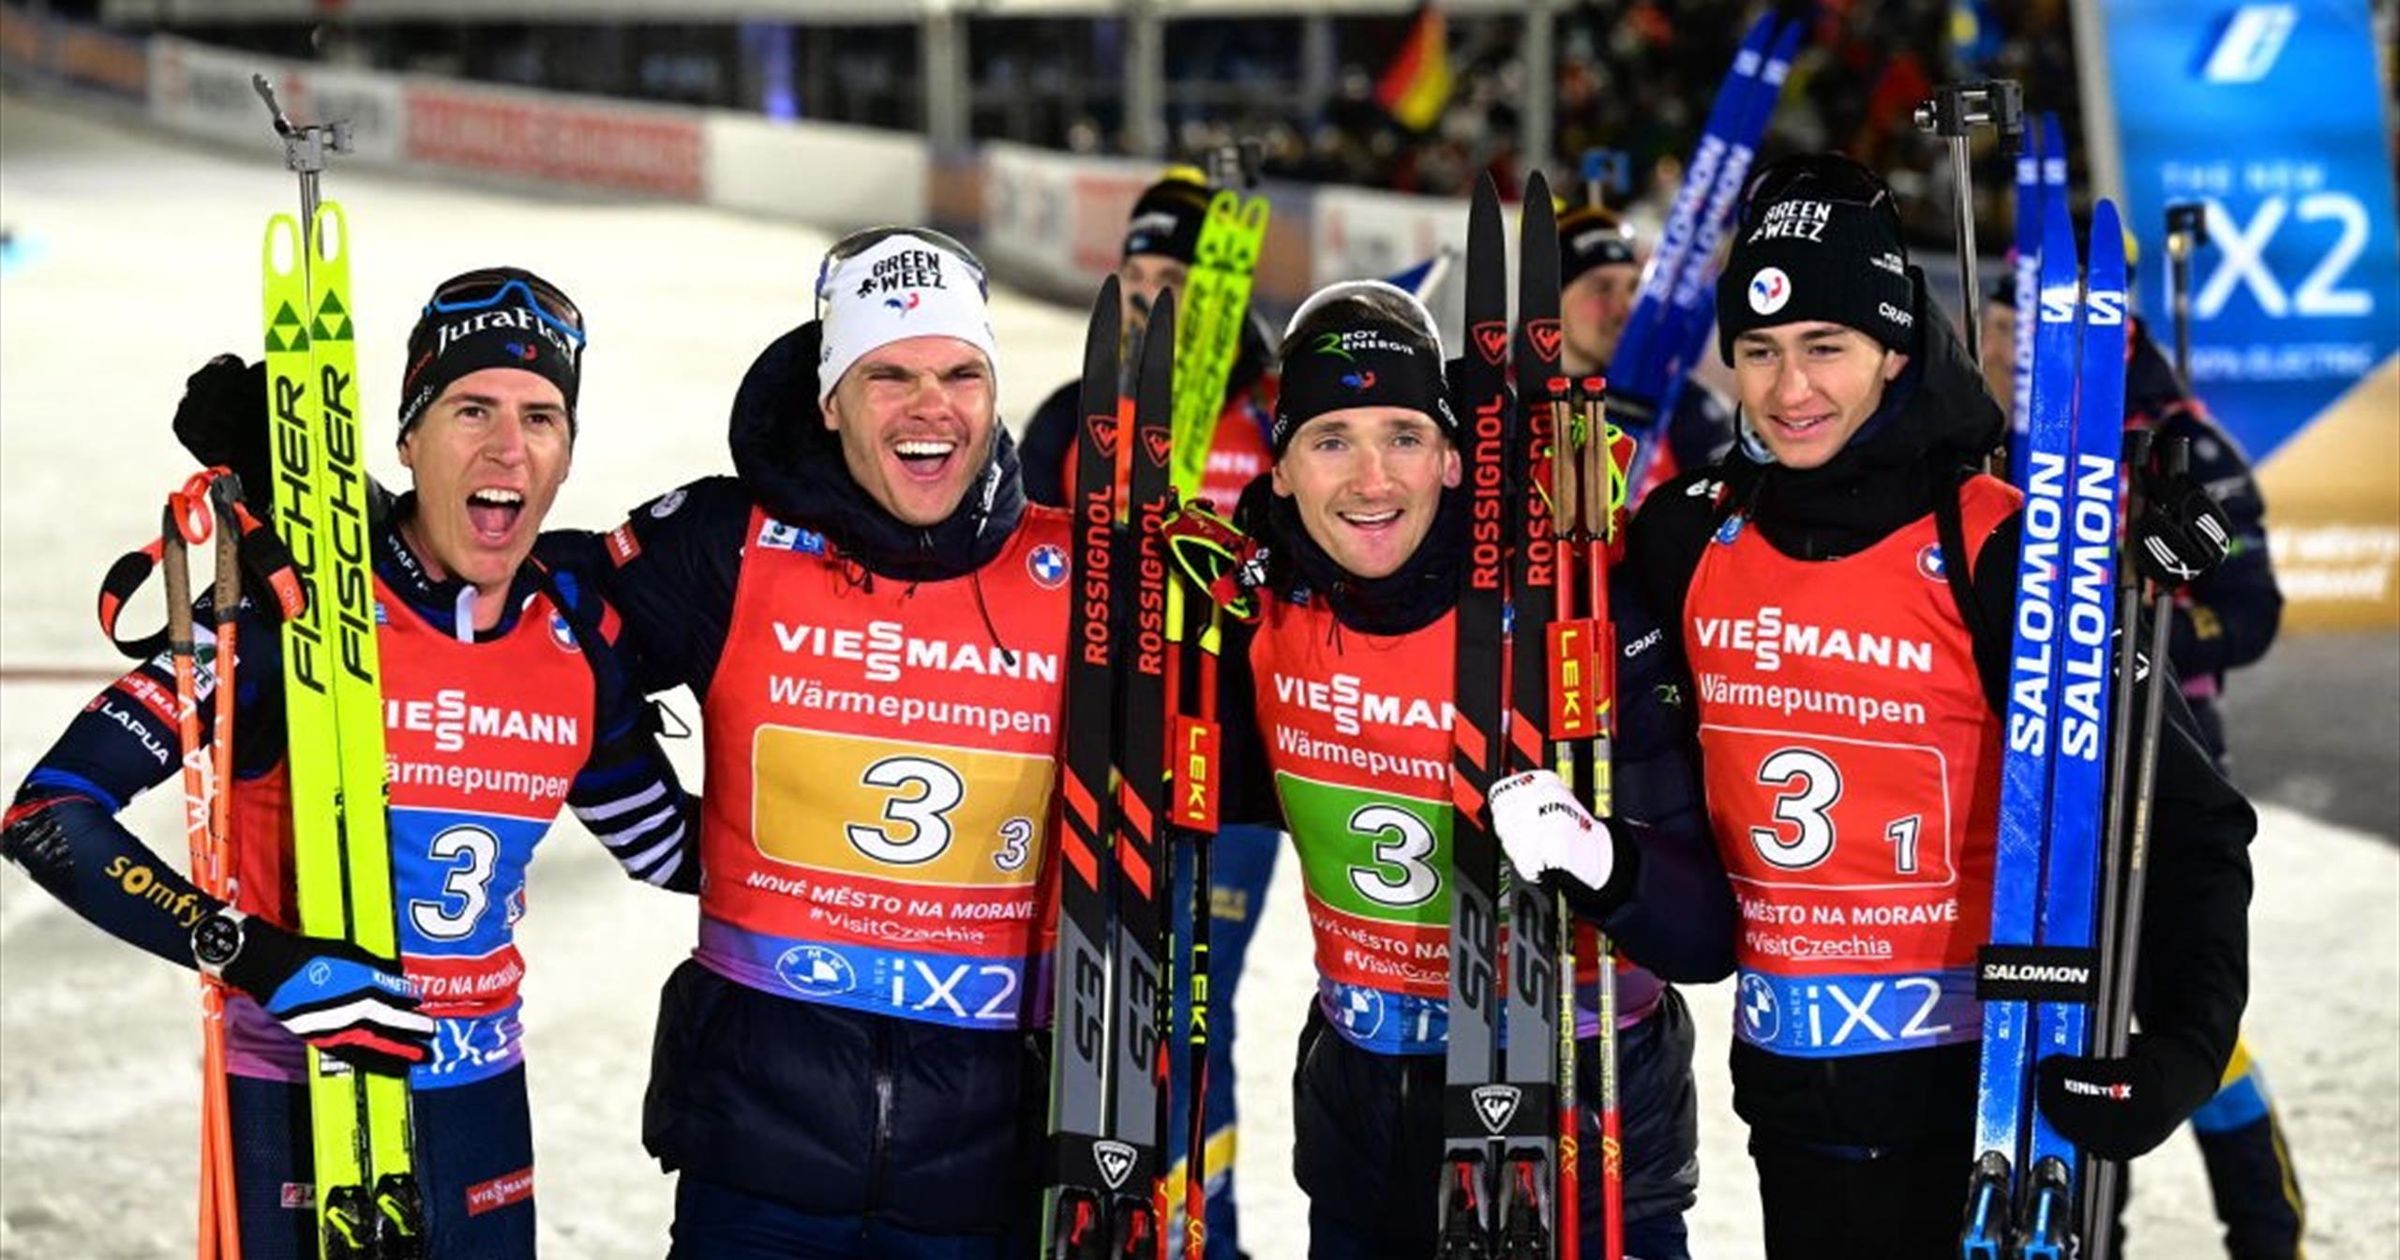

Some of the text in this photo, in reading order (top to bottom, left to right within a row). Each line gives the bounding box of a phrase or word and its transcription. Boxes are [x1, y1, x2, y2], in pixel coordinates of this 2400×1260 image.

[872, 250, 941, 277] GREEN
[880, 270, 947, 293] WEEZ
[320, 363, 373, 686] FISCHER
[1472, 395, 1501, 590] ROSSIGNOL
[1084, 484, 1112, 667] ROSSIGNOL
[1138, 494, 1166, 676] ROSSIGNOL
[2011, 451, 2067, 758] SALOMON
[2061, 453, 2117, 762] SALOMON
[771, 620, 1058, 683] VIESSMANN
[1695, 606, 1932, 673] VIESSMANN
[768, 675, 1053, 736] Wärmepumpen
[1274, 673, 1456, 736] VIESSMAN
[1561, 630, 1581, 730] LEKI
[1699, 673, 1926, 725] Wärmepumpen
[101, 701, 169, 765] LAPUA
[383, 689, 578, 752] IESSMANN
[385, 753, 569, 800] ärmepumpen
[1189, 725, 1208, 821] LEKI
[1276, 722, 1454, 790] Wärmepum
[846, 756, 964, 866] 3
[1749, 746, 1842, 869] 3
[993, 818, 1034, 871] 3
[1346, 803, 1442, 908] 3
[1884, 814, 1922, 874] 1
[104, 854, 203, 928] somfy
[410, 824, 500, 942] 3
[811, 887, 902, 914] MĚSTO
[907, 901, 944, 918] NA
[1812, 906, 1846, 925] NA
[1852, 898, 1959, 925] MORAVĚ
[1415, 943, 1451, 959] NA
[1982, 964, 2090, 984] SALOMON
[449, 976, 473, 995] NA
[891, 957, 1017, 1020] iX2
[1189, 943, 1208, 1046] LEKI
[1807, 977, 1952, 1047] iX2
